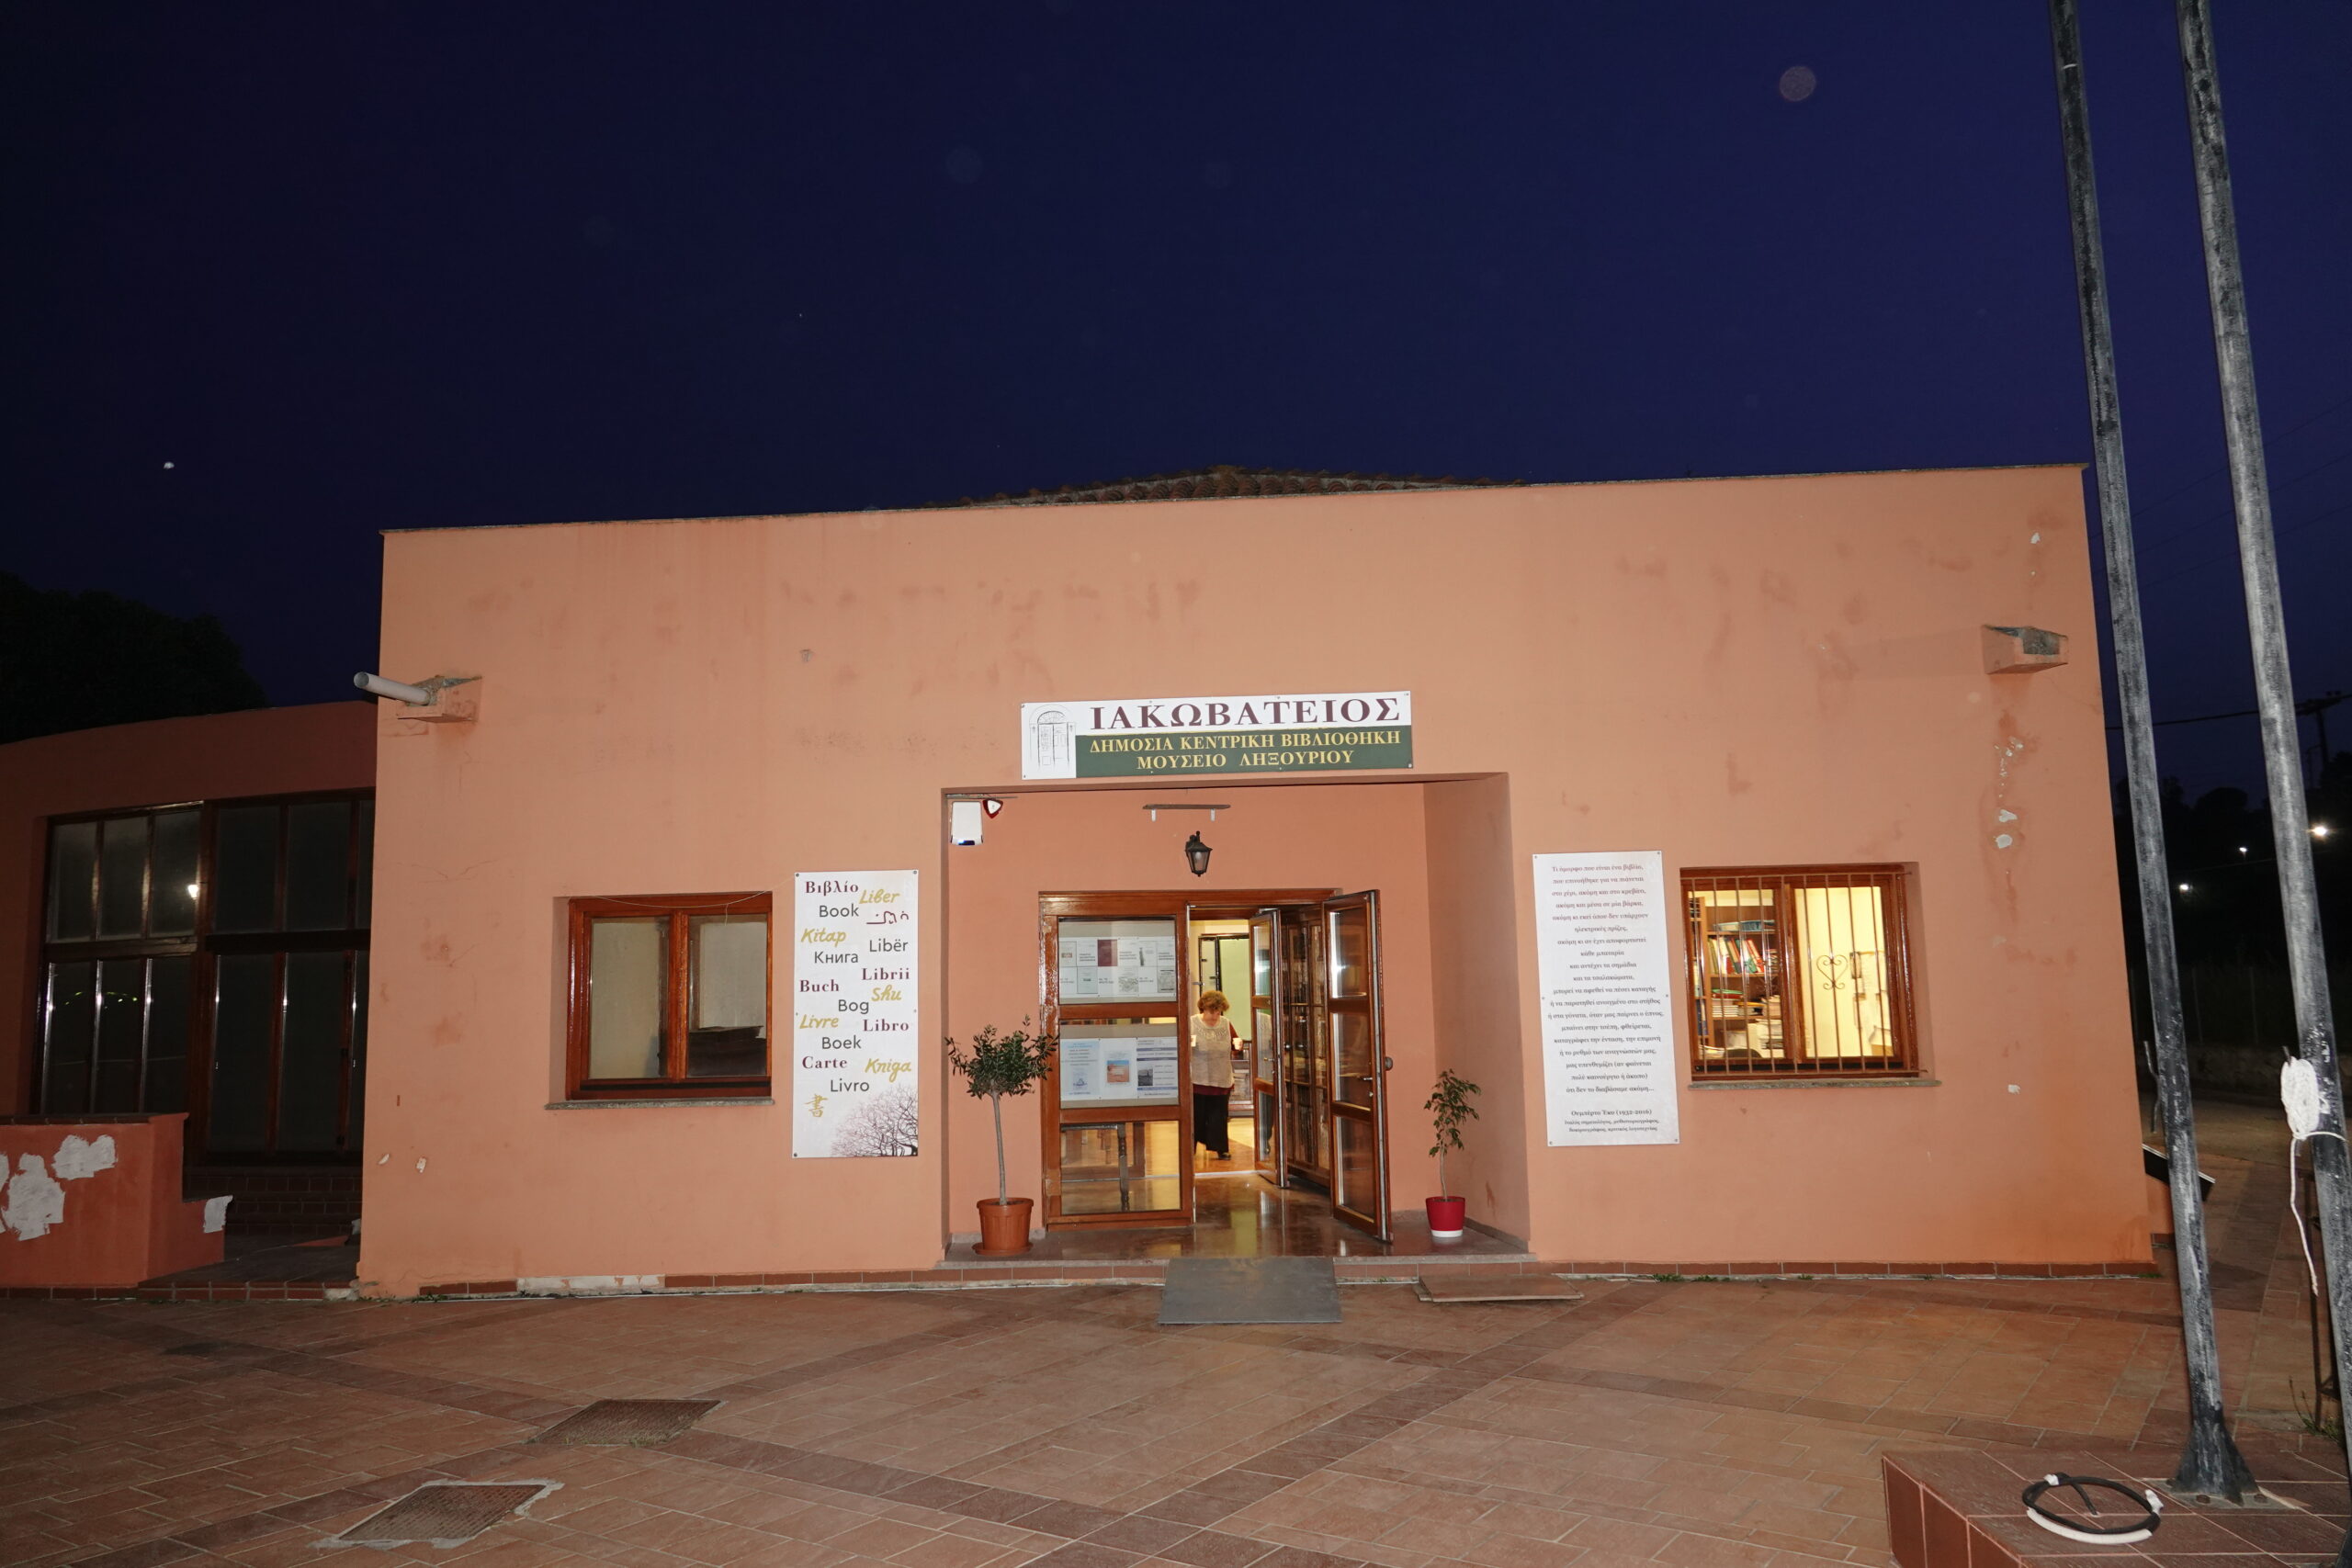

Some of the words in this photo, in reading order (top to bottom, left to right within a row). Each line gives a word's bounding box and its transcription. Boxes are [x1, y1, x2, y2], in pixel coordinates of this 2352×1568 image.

[1090, 697, 1401, 731] ΙΑΚΩΒΑΤΕΙΟΣ
[1090, 736, 1173, 753] ΔΗΜΟΣΙΑ
[1180, 733, 1275, 750] ΚΕΝΤΡΙΚΗ
[1281, 730, 1402, 748] ΒΙΒΛΙΟΘΗΚΗ
[1136, 753, 1227, 770] ΜΟΥΣΕΙΟ
[1238, 750, 1354, 767] ΛΗΞΟΥΡΙΟΥ
[805, 880, 859, 897] Βιβλίο
[859, 888, 899, 905] Liber
[819, 904, 859, 918] Book
[800, 928, 847, 946] Kitap
[869, 938, 909, 953] Libër
[814, 950, 858, 964] Книга
[861, 967, 910, 981] Librii
[799, 979, 840, 993] Buch
[871, 985, 902, 1002] Shu
[838, 999, 869, 1014] Bog
[799, 1013, 839, 1029] Livre
[862, 1019, 910, 1032] Libro
[821, 1035, 862, 1050] Boek
[802, 1055, 847, 1070] Carte
[865, 1057, 911, 1083] Kniga
[830, 1078, 870, 1092] Livro
